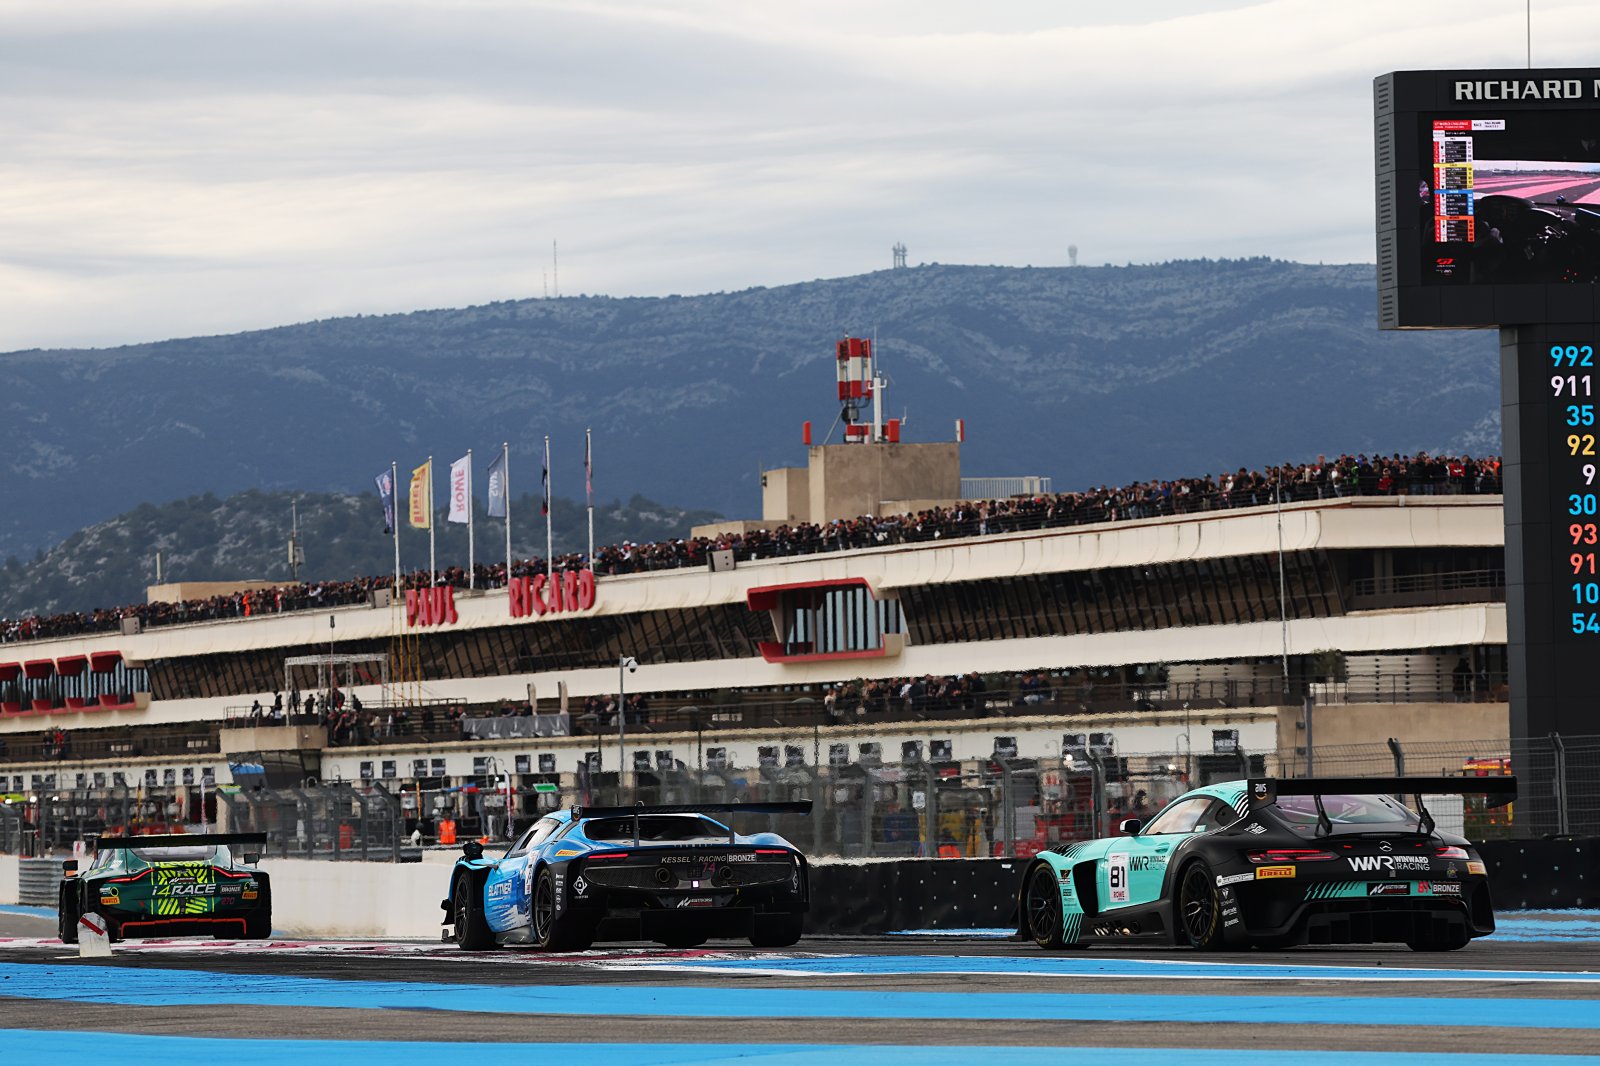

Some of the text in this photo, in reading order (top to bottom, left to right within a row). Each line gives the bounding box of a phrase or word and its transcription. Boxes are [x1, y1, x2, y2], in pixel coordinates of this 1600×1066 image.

[1455, 79, 1582, 100] RICHARD
[1550, 345, 1594, 367] 992
[1550, 375, 1591, 397] 911
[1566, 405, 1595, 426] 35
[1567, 434, 1595, 456] 92
[1582, 464, 1596, 485] 9
[1568, 493, 1597, 515] 30
[1569, 523, 1598, 545] 93
[1570, 552, 1596, 575] 91
[405, 568, 596, 628] PAUL RICARD
[1572, 582, 1599, 604] 10
[1572, 612, 1600, 634] 54
[661, 855, 727, 864] KESSEL RACING
[728, 853, 756, 863] BRONZE
[1393, 855, 1429, 864] WINWARD
[1396, 862, 1431, 871] RACING
[1110, 866, 1126, 888] 81
[1259, 867, 1292, 877] PIRELLI
[1432, 884, 1460, 893] BRONZE
